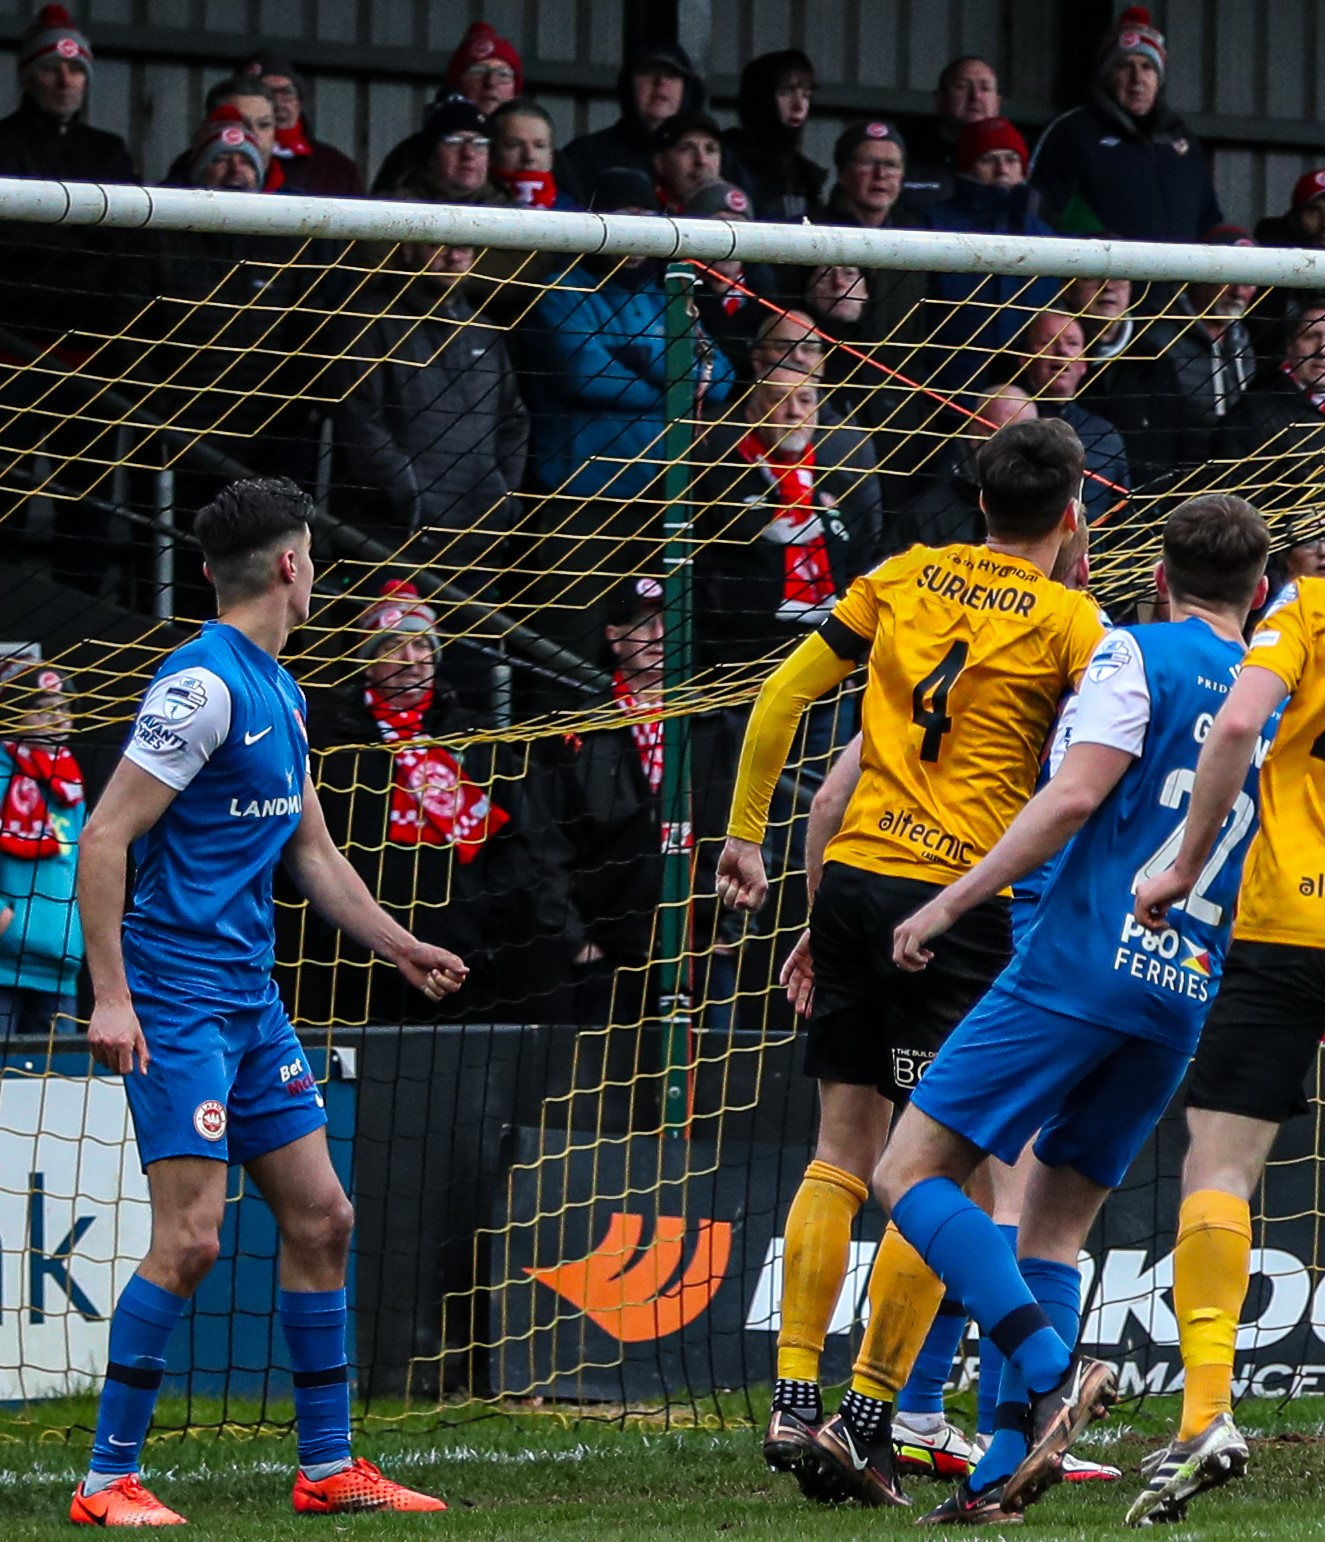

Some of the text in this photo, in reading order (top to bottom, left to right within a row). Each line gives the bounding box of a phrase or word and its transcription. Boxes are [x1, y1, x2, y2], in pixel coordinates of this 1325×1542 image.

[911, 640, 969, 763] 4
[878, 809, 975, 865] altecnic
[1131, 768, 1255, 927] 22
[1113, 947, 1209, 1003] FERRIES
[279, 1057, 304, 1083] Bet
